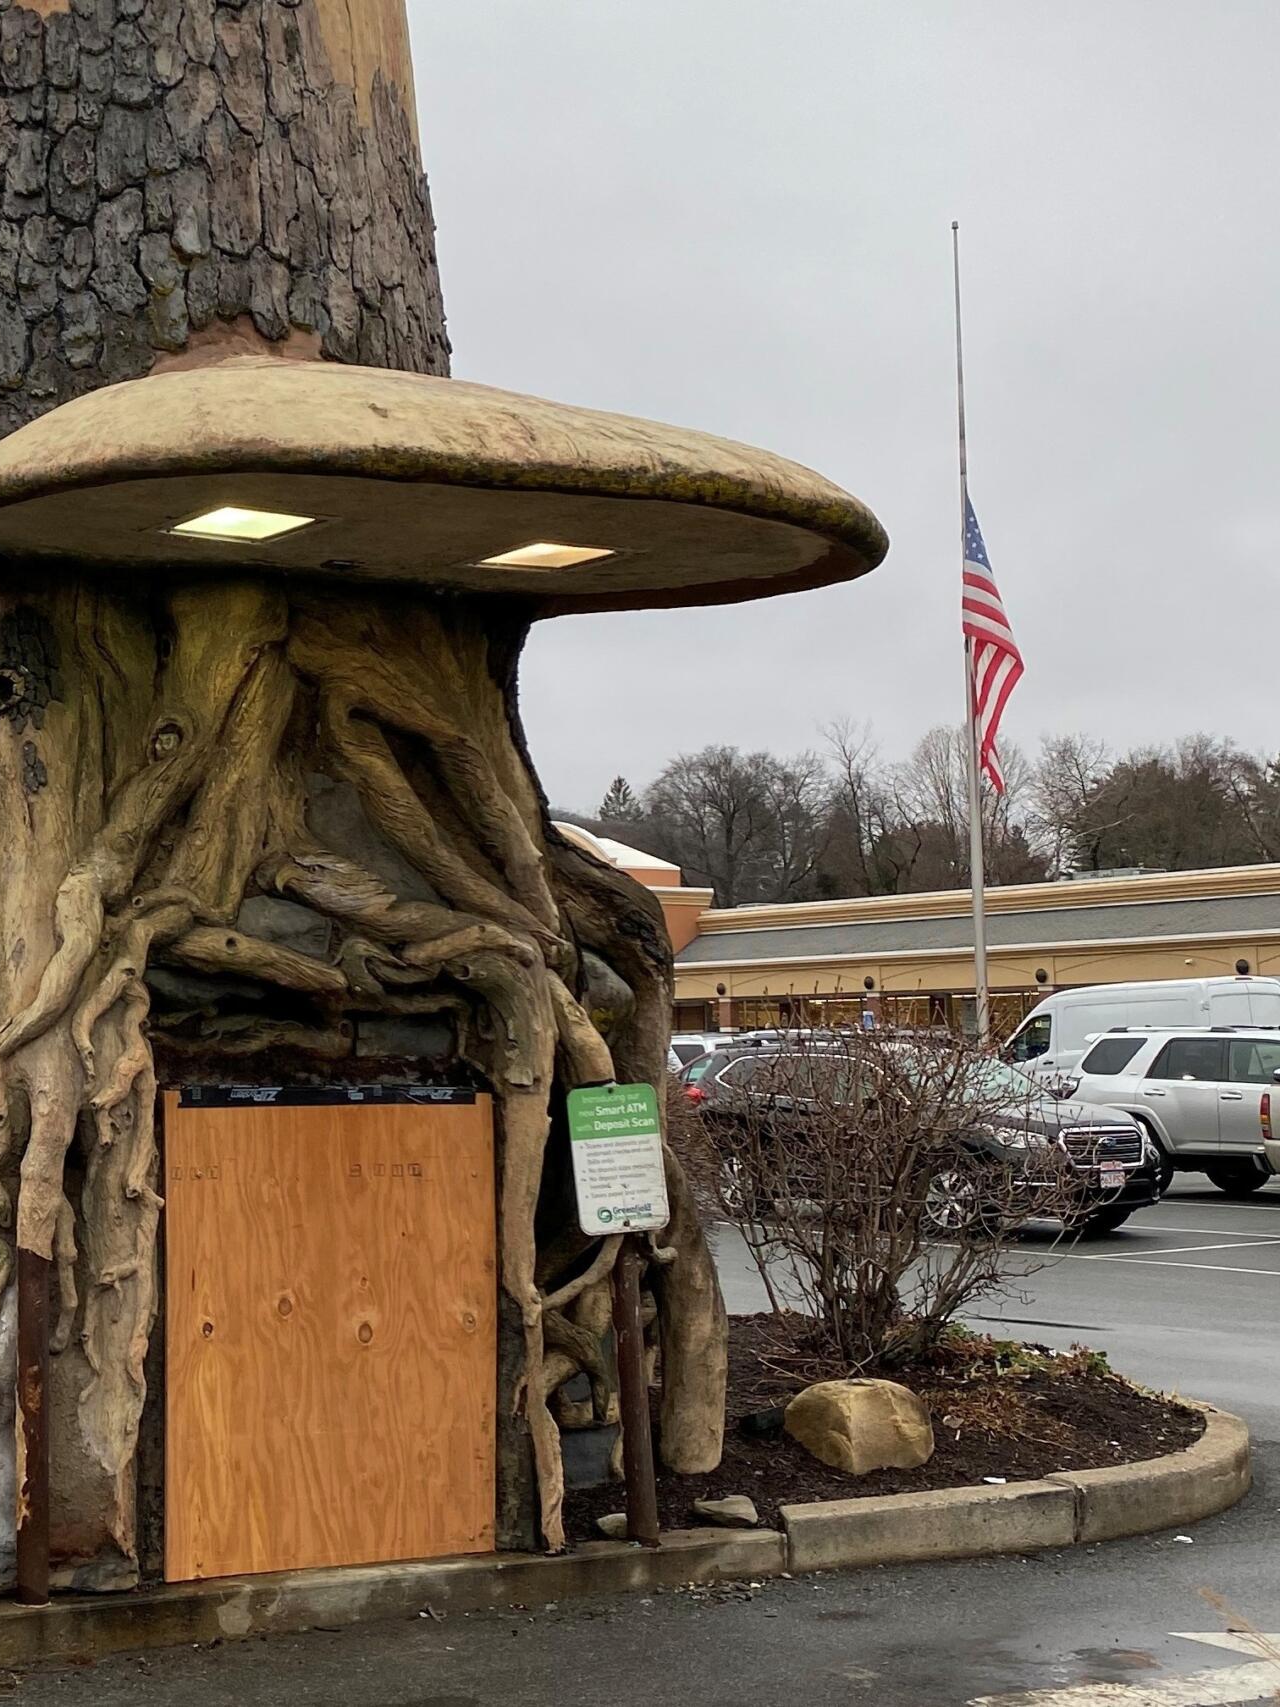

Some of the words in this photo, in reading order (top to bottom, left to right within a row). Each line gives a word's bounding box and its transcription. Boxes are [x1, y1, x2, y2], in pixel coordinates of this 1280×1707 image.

[595, 1105, 625, 1116] Smart
[626, 1102, 648, 1113] ATM
[593, 1119, 630, 1131] Deposit
[631, 1117, 655, 1127] Scan
